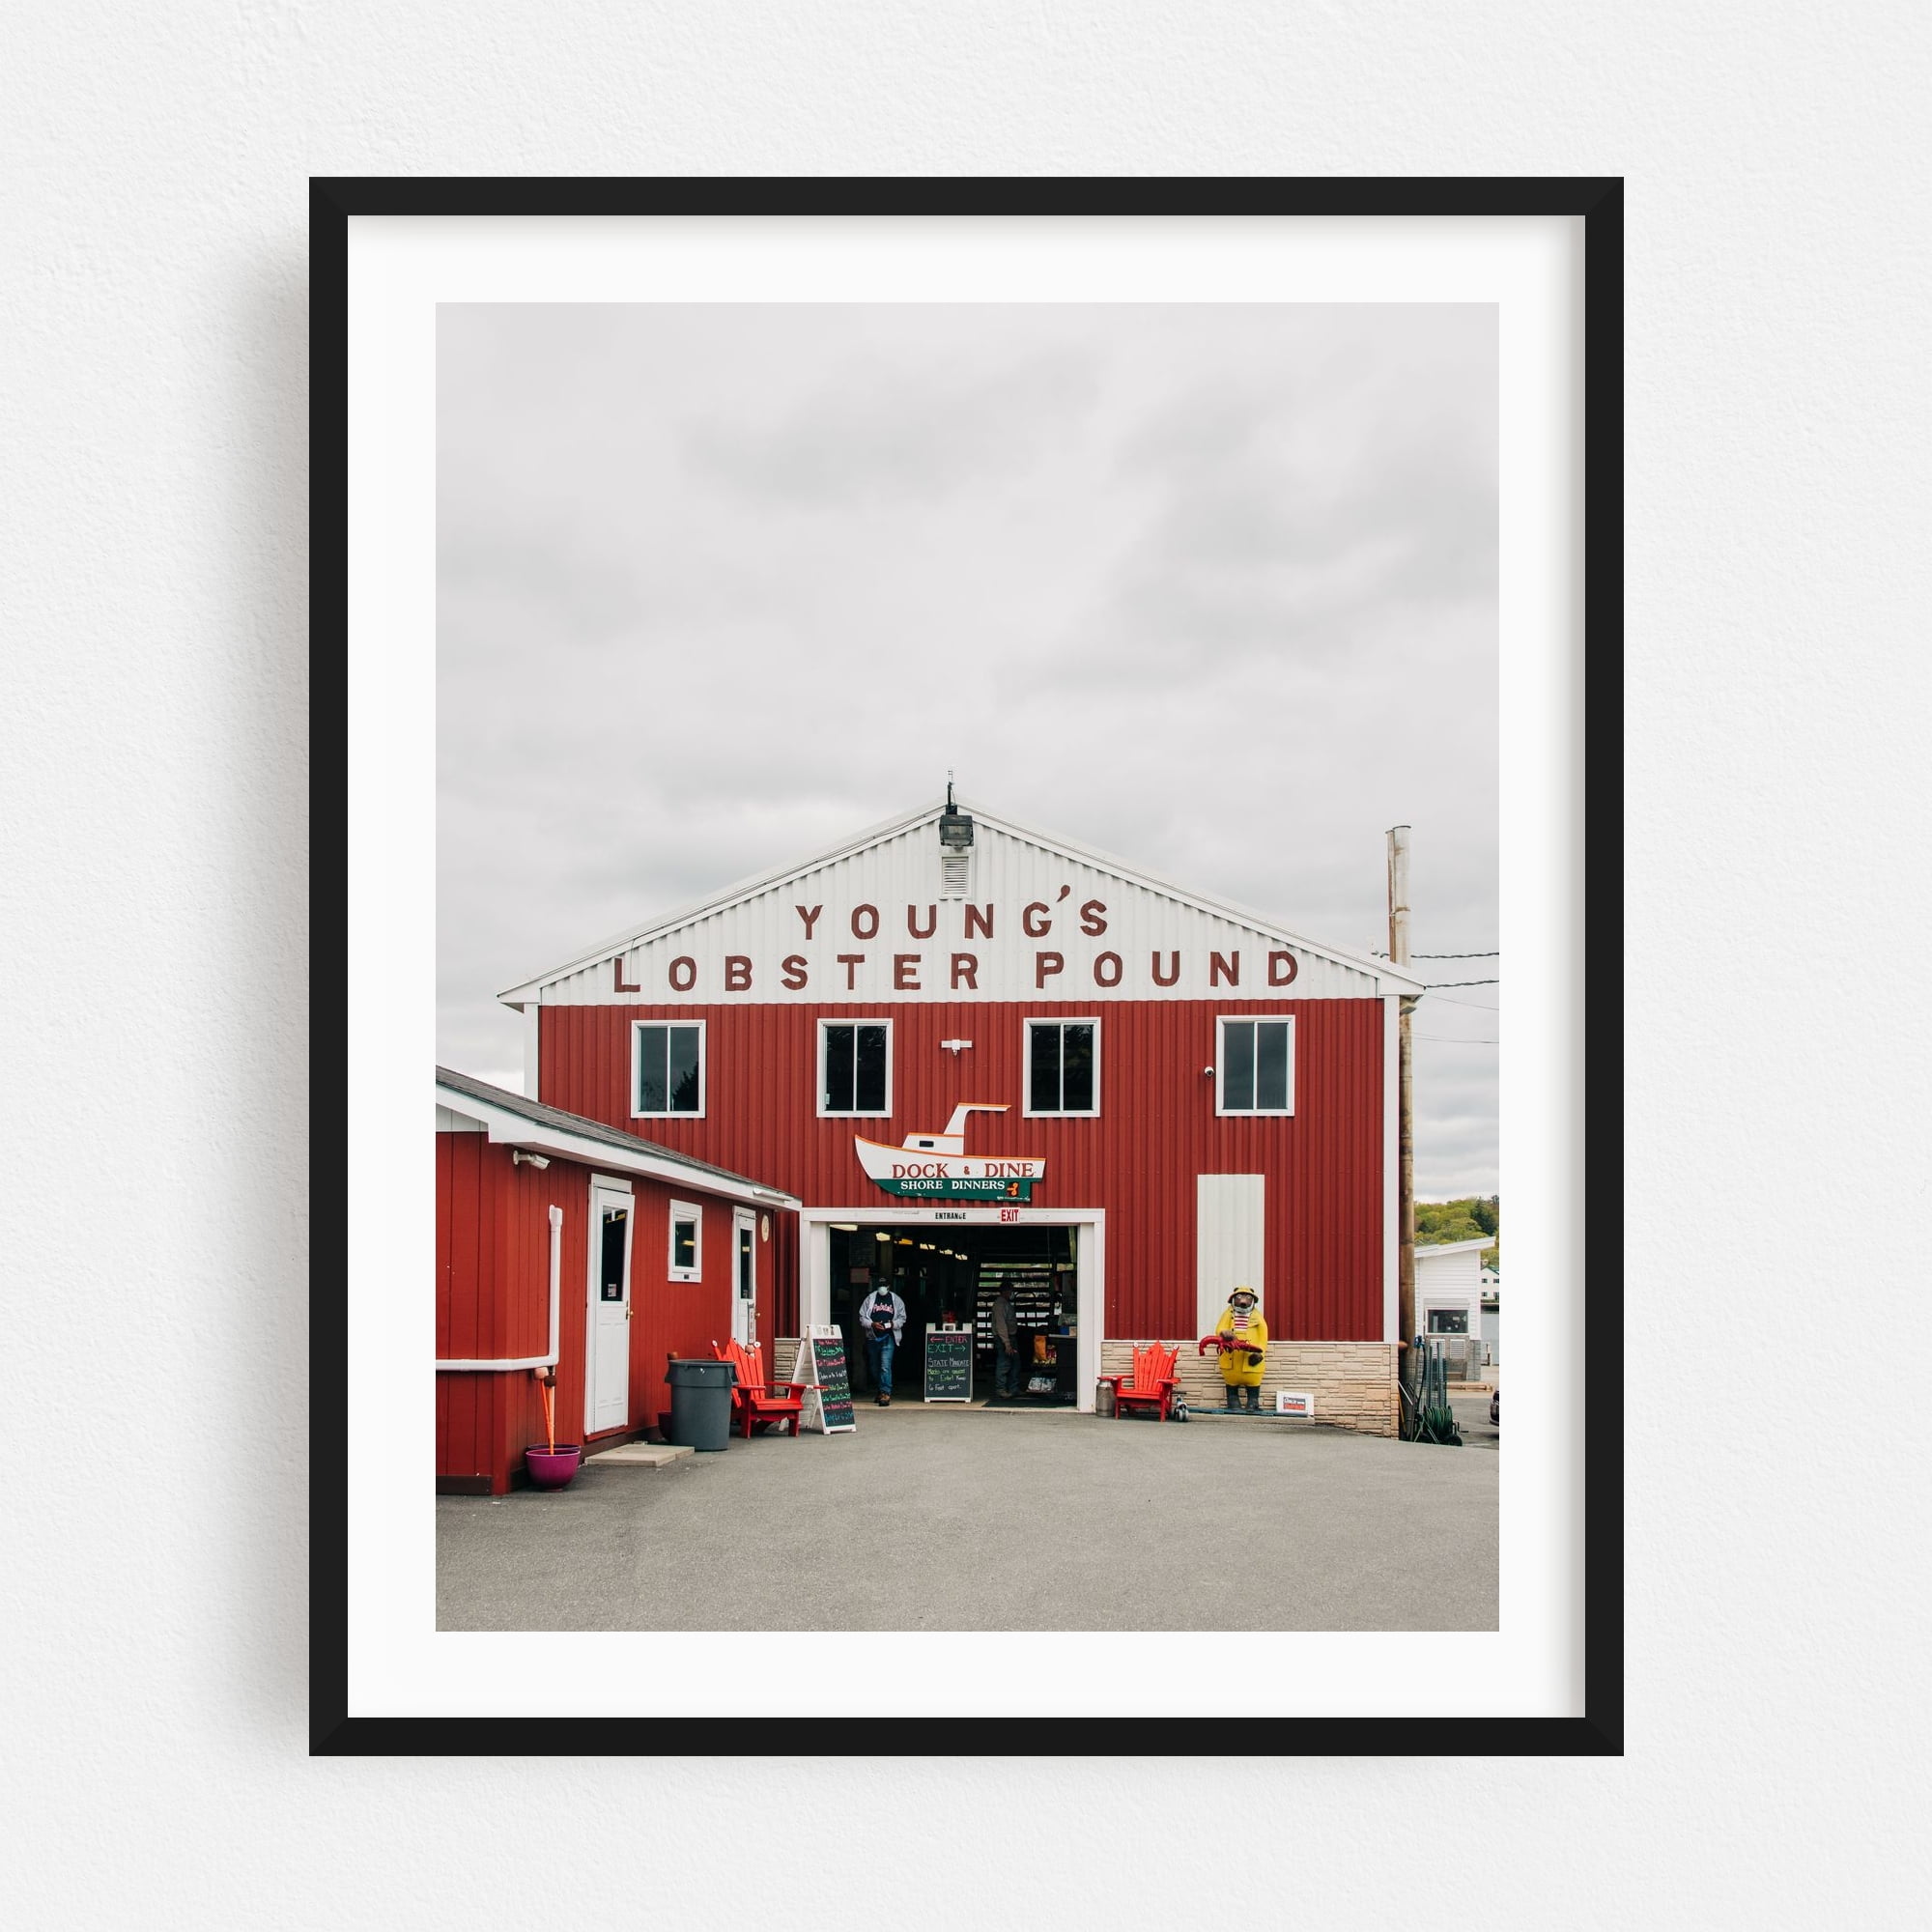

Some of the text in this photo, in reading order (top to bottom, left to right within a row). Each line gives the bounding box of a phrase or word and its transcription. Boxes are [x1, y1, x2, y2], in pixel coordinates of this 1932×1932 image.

[796, 885, 1108, 941] YOUNG'S
[614, 951, 1299, 994] LOBSTER POUND
[892, 1162, 1034, 1178] DOCK & DINE
[900, 1180, 1005, 1189] SHORE DINNERS
[1001, 1209, 1019, 1221] EXIT
[927, 1344, 953, 1352] EXIT
